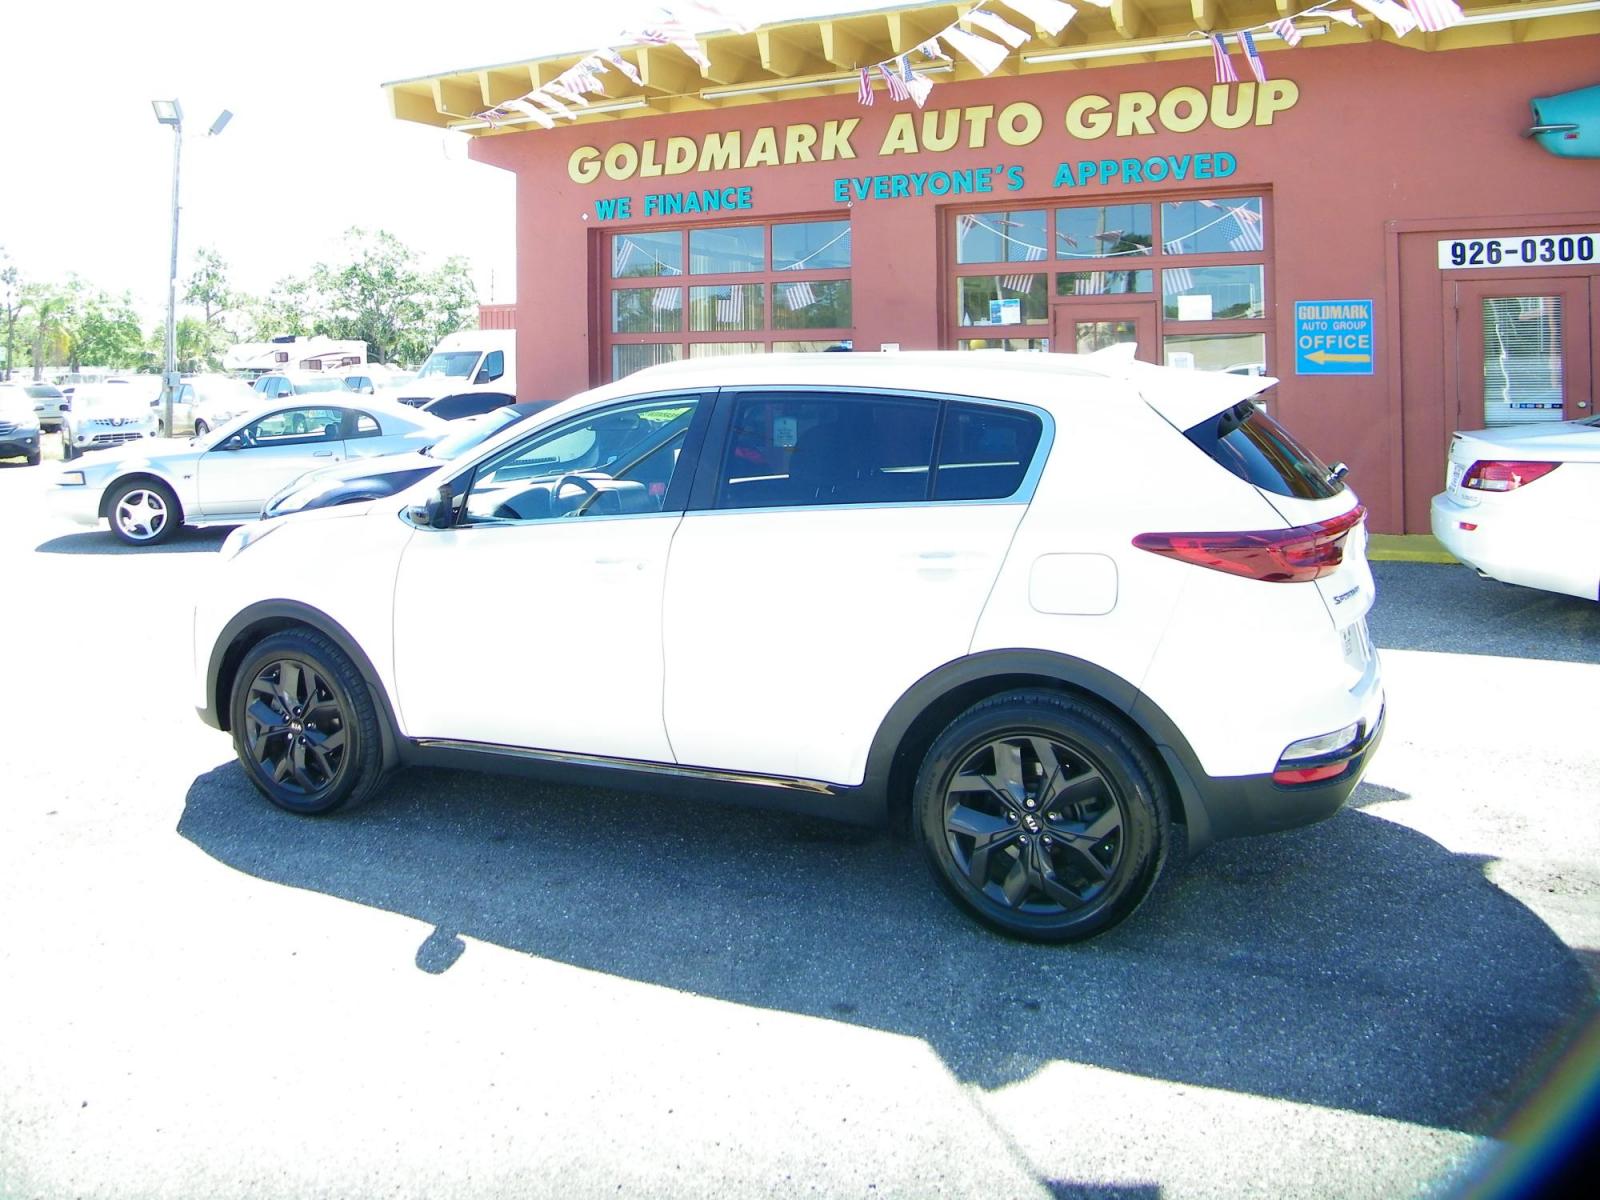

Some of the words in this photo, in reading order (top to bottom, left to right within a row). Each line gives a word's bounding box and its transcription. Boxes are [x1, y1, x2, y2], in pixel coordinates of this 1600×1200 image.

[567, 118, 861, 184] GOLDMARK
[879, 101, 1043, 156] AUTO
[1065, 79, 1299, 141] GROUP
[834, 165, 1025, 202] EVERYONE'S
[1053, 152, 1238, 189] APPROVED
[595, 196, 631, 221] WE
[644, 186, 753, 217] FINANCE
[1450, 235, 1594, 266] 926-0300
[1298, 305, 1369, 320] GOLDMARK
[1302, 321, 1328, 331] AUTO
[1332, 320, 1367, 331] GROUP
[1299, 334, 1370, 349] OFFICE
